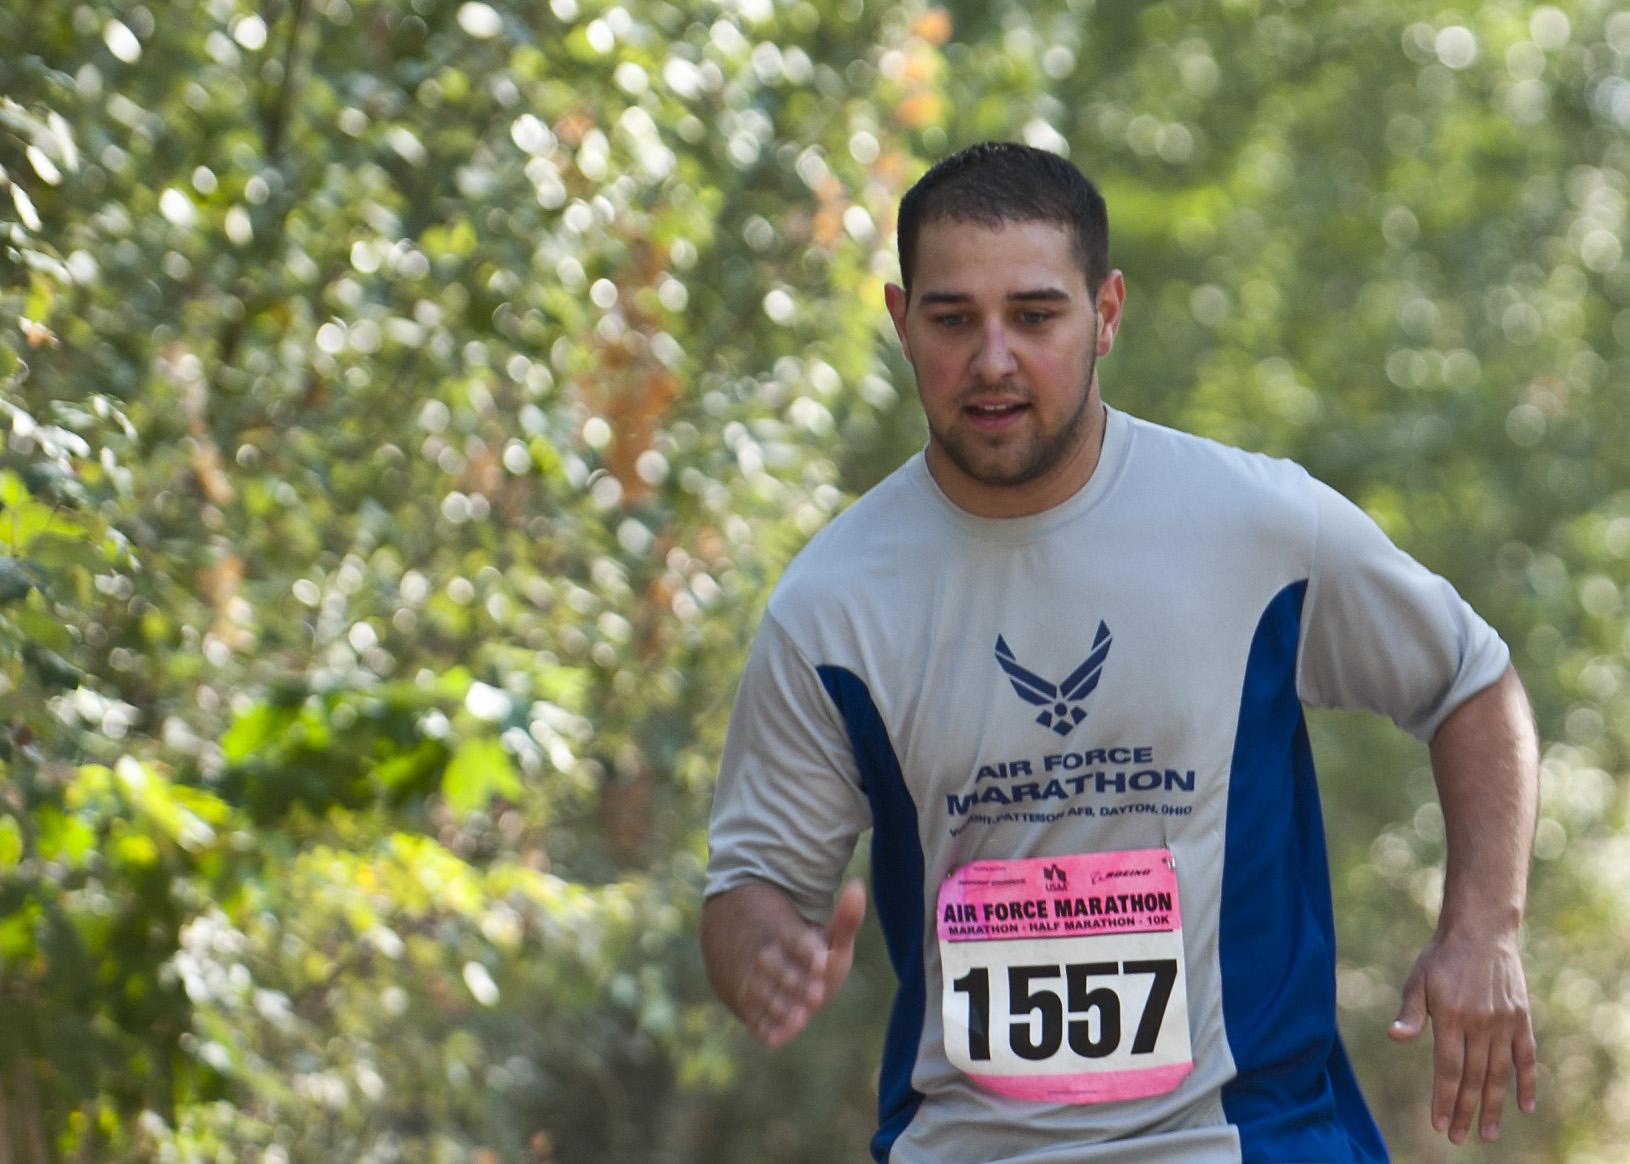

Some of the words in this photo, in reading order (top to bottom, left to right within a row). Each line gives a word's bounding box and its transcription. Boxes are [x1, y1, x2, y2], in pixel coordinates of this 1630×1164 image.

[975, 761, 1032, 782] AIR
[1044, 747, 1153, 771] FORCE
[946, 770, 1196, 816] MARATHON
[1068, 806, 1095, 817] AFB,
[1100, 803, 1158, 816] DAYTON,
[1161, 804, 1192, 816] OHIO
[943, 903, 977, 923] AIR
[983, 899, 1048, 921] FORCE
[1054, 892, 1173, 918] MARATHON
[948, 923, 1019, 936] MARATHON
[1029, 921, 1060, 932] HALF
[1064, 917, 1135, 931] MARATHON
[1147, 915, 1170, 925] 10K
[953, 959, 1178, 1061] 1557
